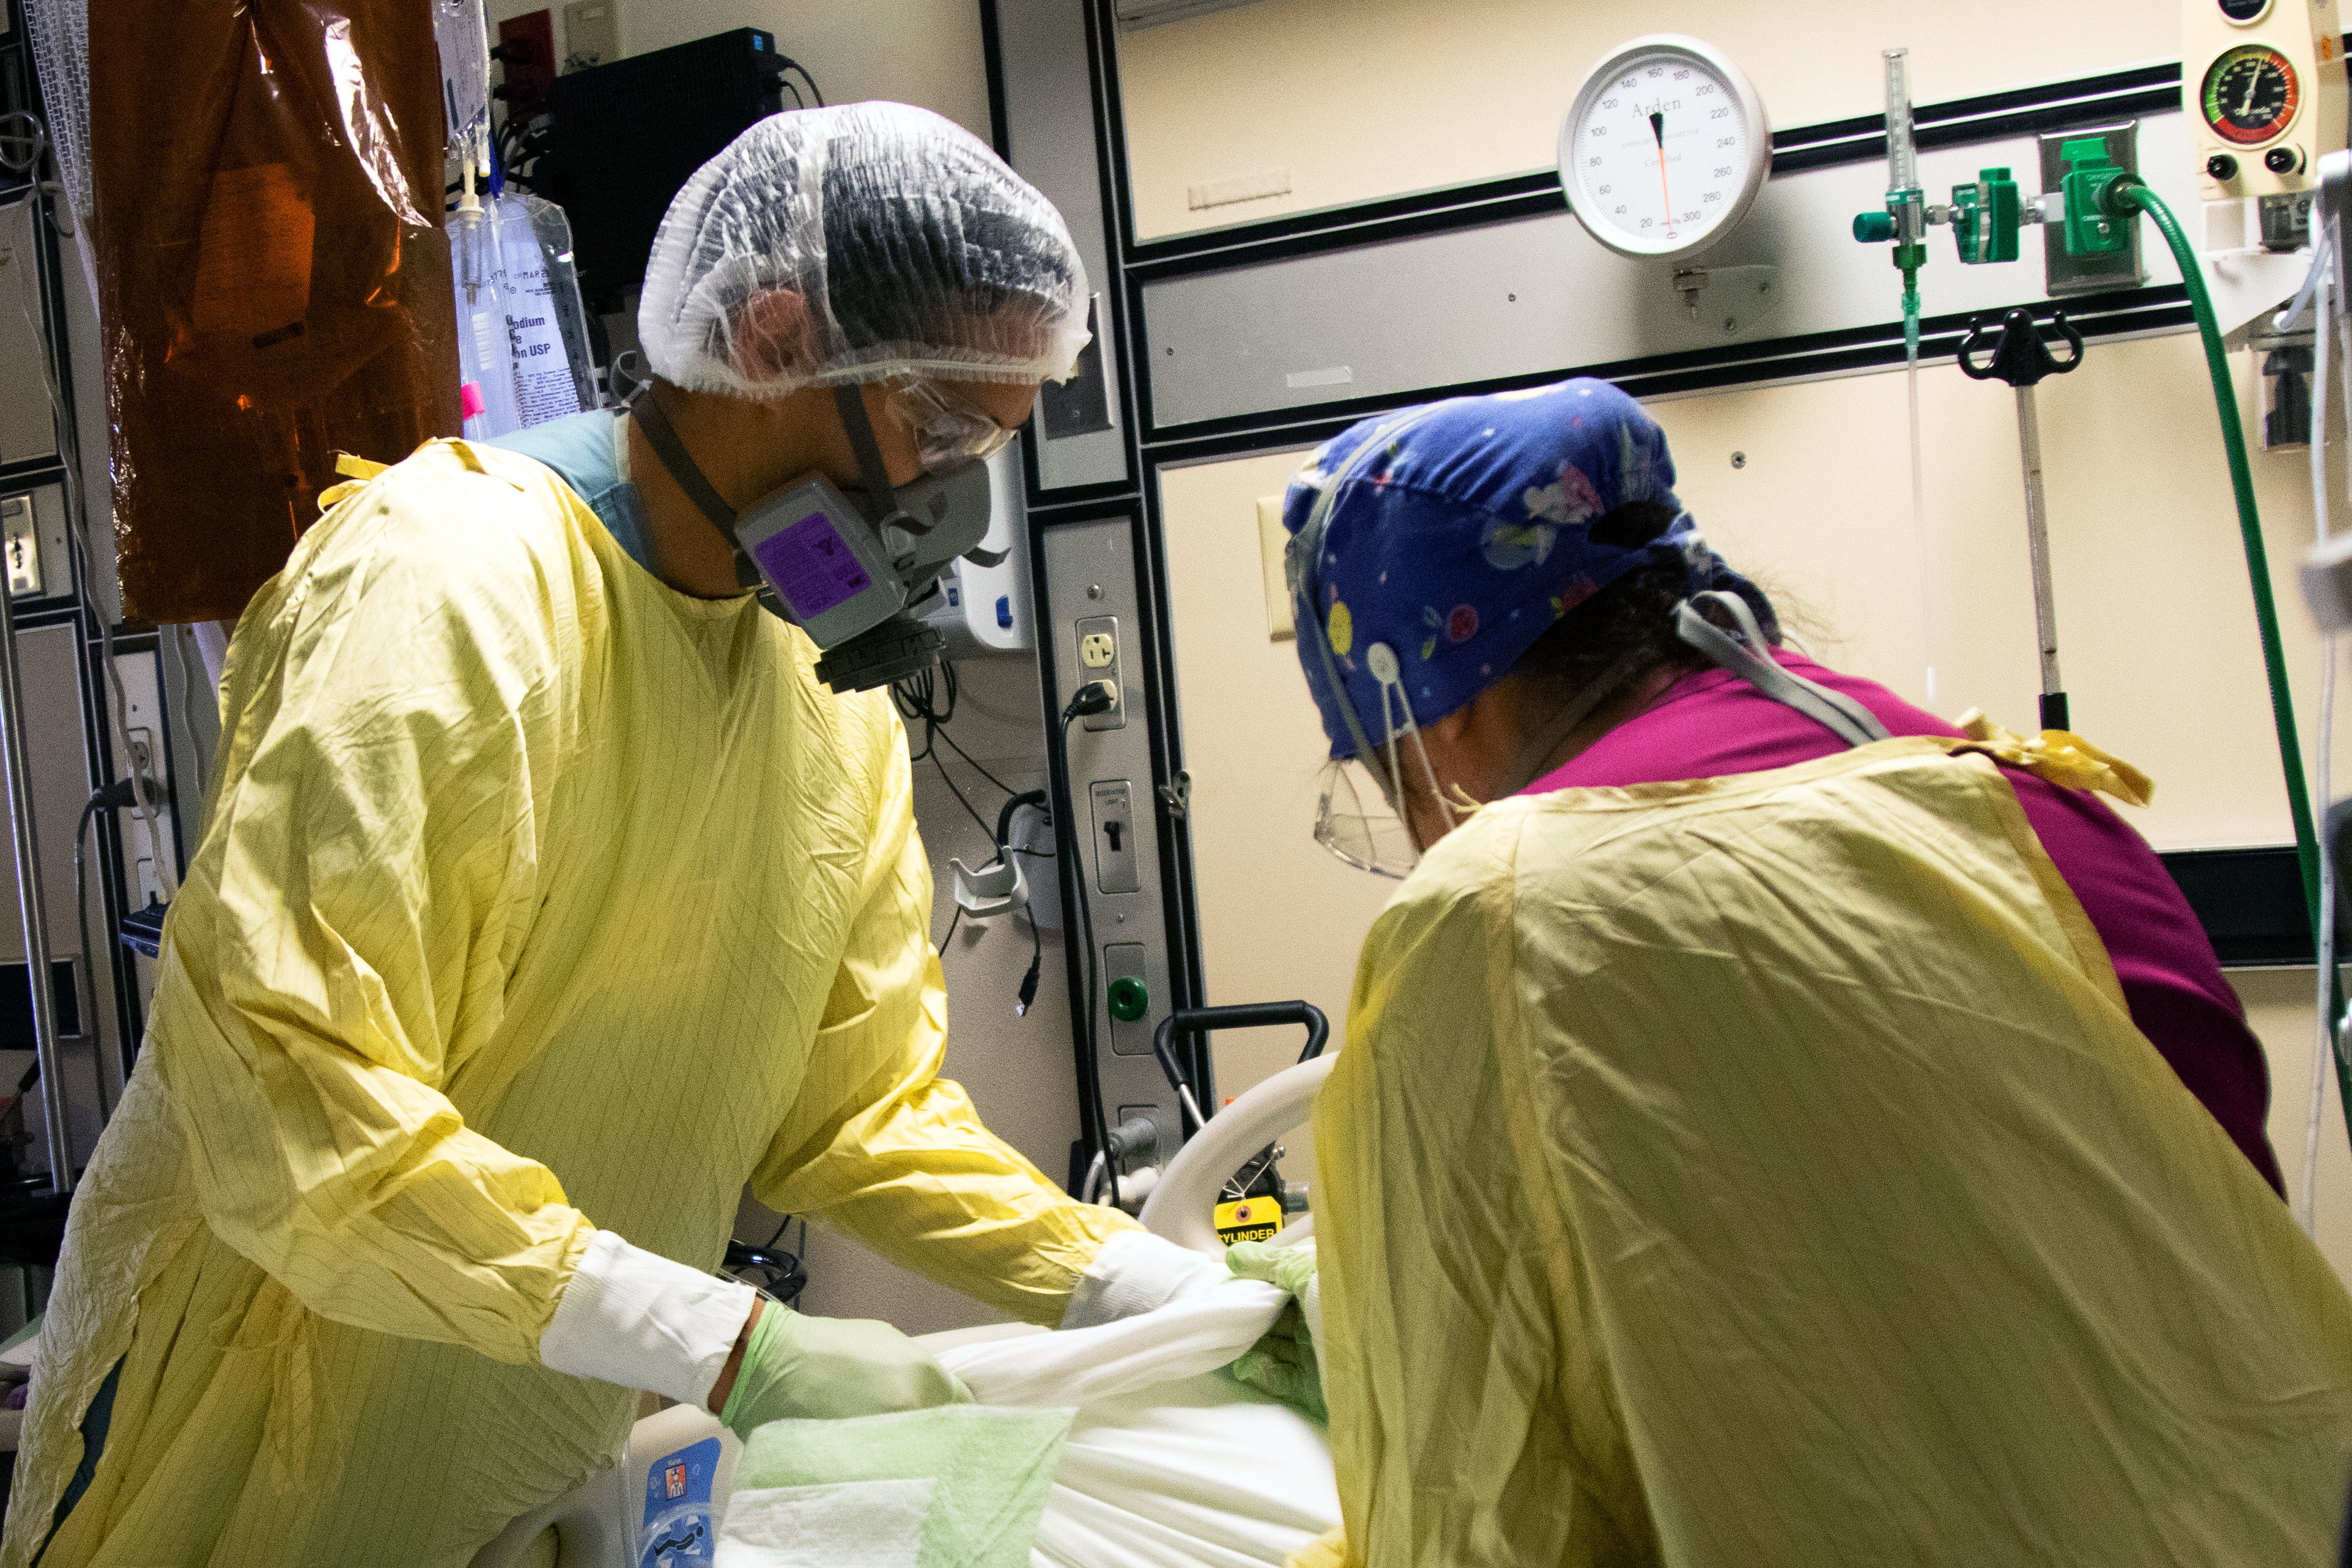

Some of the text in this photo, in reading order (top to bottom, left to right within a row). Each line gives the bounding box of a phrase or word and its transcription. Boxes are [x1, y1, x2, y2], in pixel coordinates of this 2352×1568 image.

[1648, 68, 1663, 78] 160
[1673, 70, 1690, 81] 180
[1621, 78, 1637, 89] 140
[1696, 84, 1714, 96] 200
[1602, 98, 1618, 109] 120
[1632, 97, 1681, 118] Arden
[1711, 107, 1729, 119] 220
[1591, 126, 1607, 137] 100
[1717, 136, 1735, 148] 240
[1590, 157, 1602, 167] 80
[1714, 166, 1732, 177] 260
[1599, 185, 1611, 195] 60
[1703, 191, 1721, 203] 280
[1615, 205, 1627, 215] 40
[1683, 210, 1701, 222] 300
[1641, 218, 1652, 228] 20
[513, 317, 545, 330] odium
[530, 344, 550, 356] USP
[1219, 1229, 1274, 1243] YLINDER
